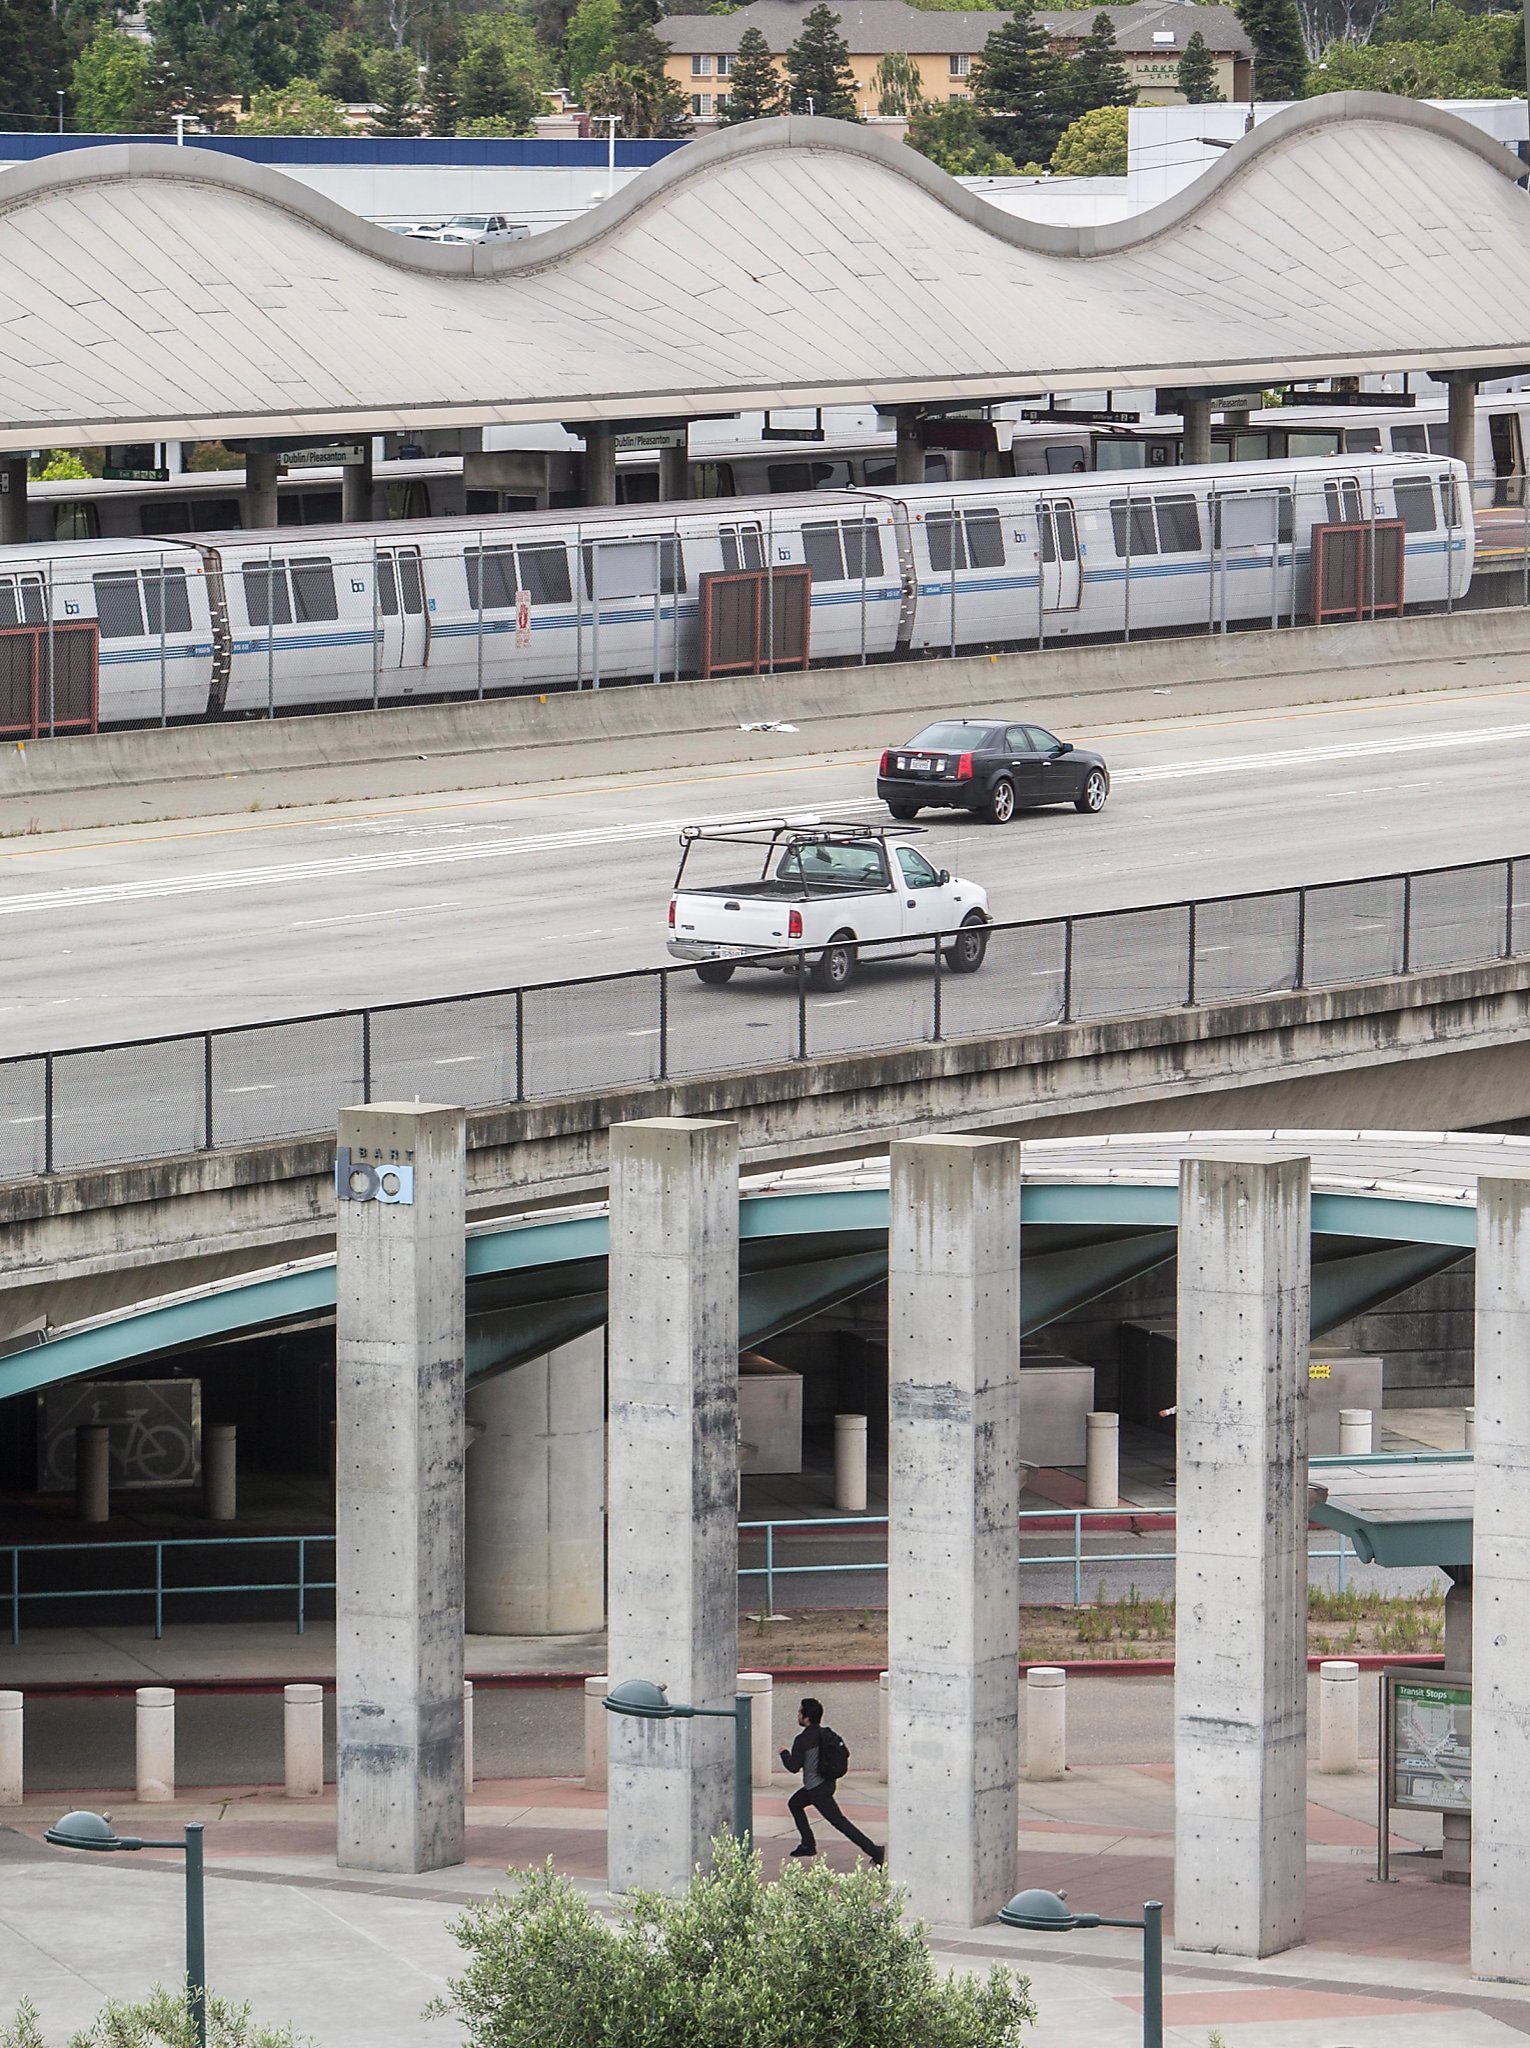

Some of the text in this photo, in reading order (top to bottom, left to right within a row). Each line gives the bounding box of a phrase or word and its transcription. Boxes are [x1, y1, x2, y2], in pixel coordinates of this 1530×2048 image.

[283, 451, 347, 464] Dublin/Pleasanton
[359, 1147, 414, 1161] BART
[1400, 1686, 1448, 1700] Transit Stops
